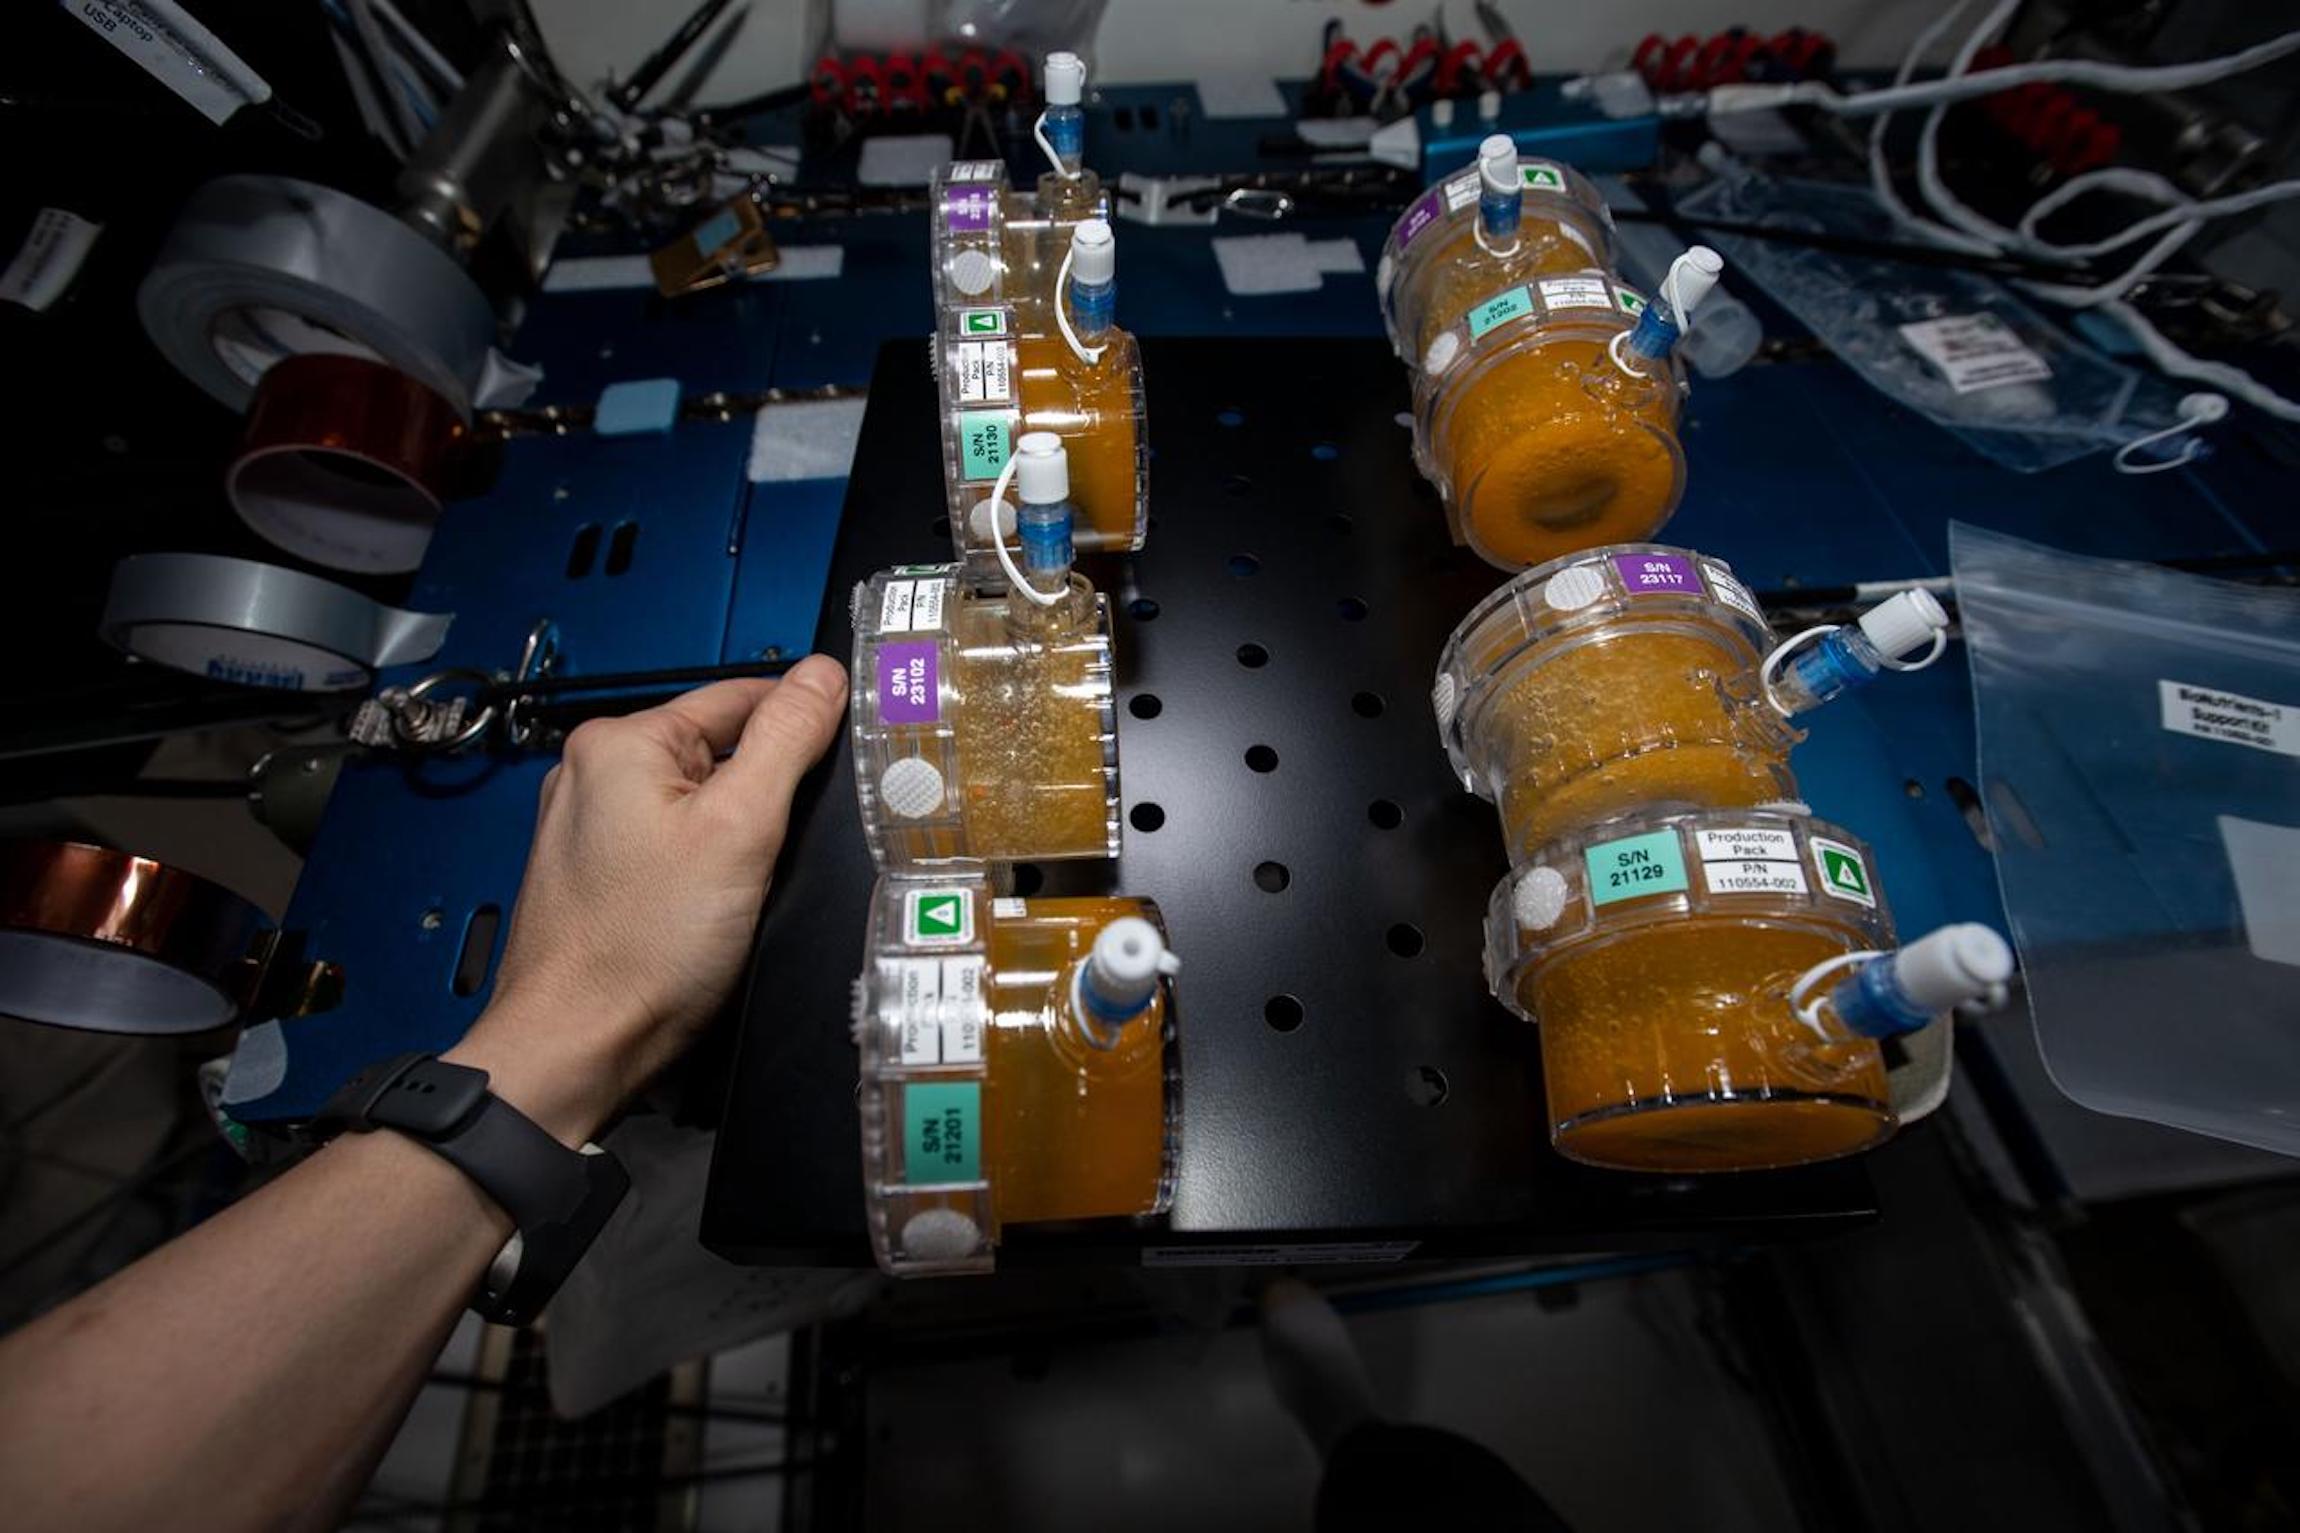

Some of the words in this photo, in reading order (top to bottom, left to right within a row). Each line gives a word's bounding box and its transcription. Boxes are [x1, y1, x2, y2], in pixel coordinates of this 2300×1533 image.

[83, 3, 118, 33] USB
[973, 433, 985, 457] S/N
[986, 425, 1000, 464] 21130
[1640, 573, 1684, 585] 23117
[1643, 561, 1672, 573] S/N
[891, 667, 908, 697] S/N
[910, 657, 926, 706] 23102
[1707, 831, 1785, 845] Production
[1732, 844, 1768, 856] Pack
[1617, 848, 1650, 867] S/N
[1742, 862, 1768, 875] P/N
[1610, 864, 1665, 887] 21129
[1718, 877, 1797, 890] 110554-002
[904, 970, 919, 1053] Proction
[961, 967, 975, 1050] 110-002
[922, 1118, 942, 1154] S/N
[944, 1108, 963, 1164] 21201
